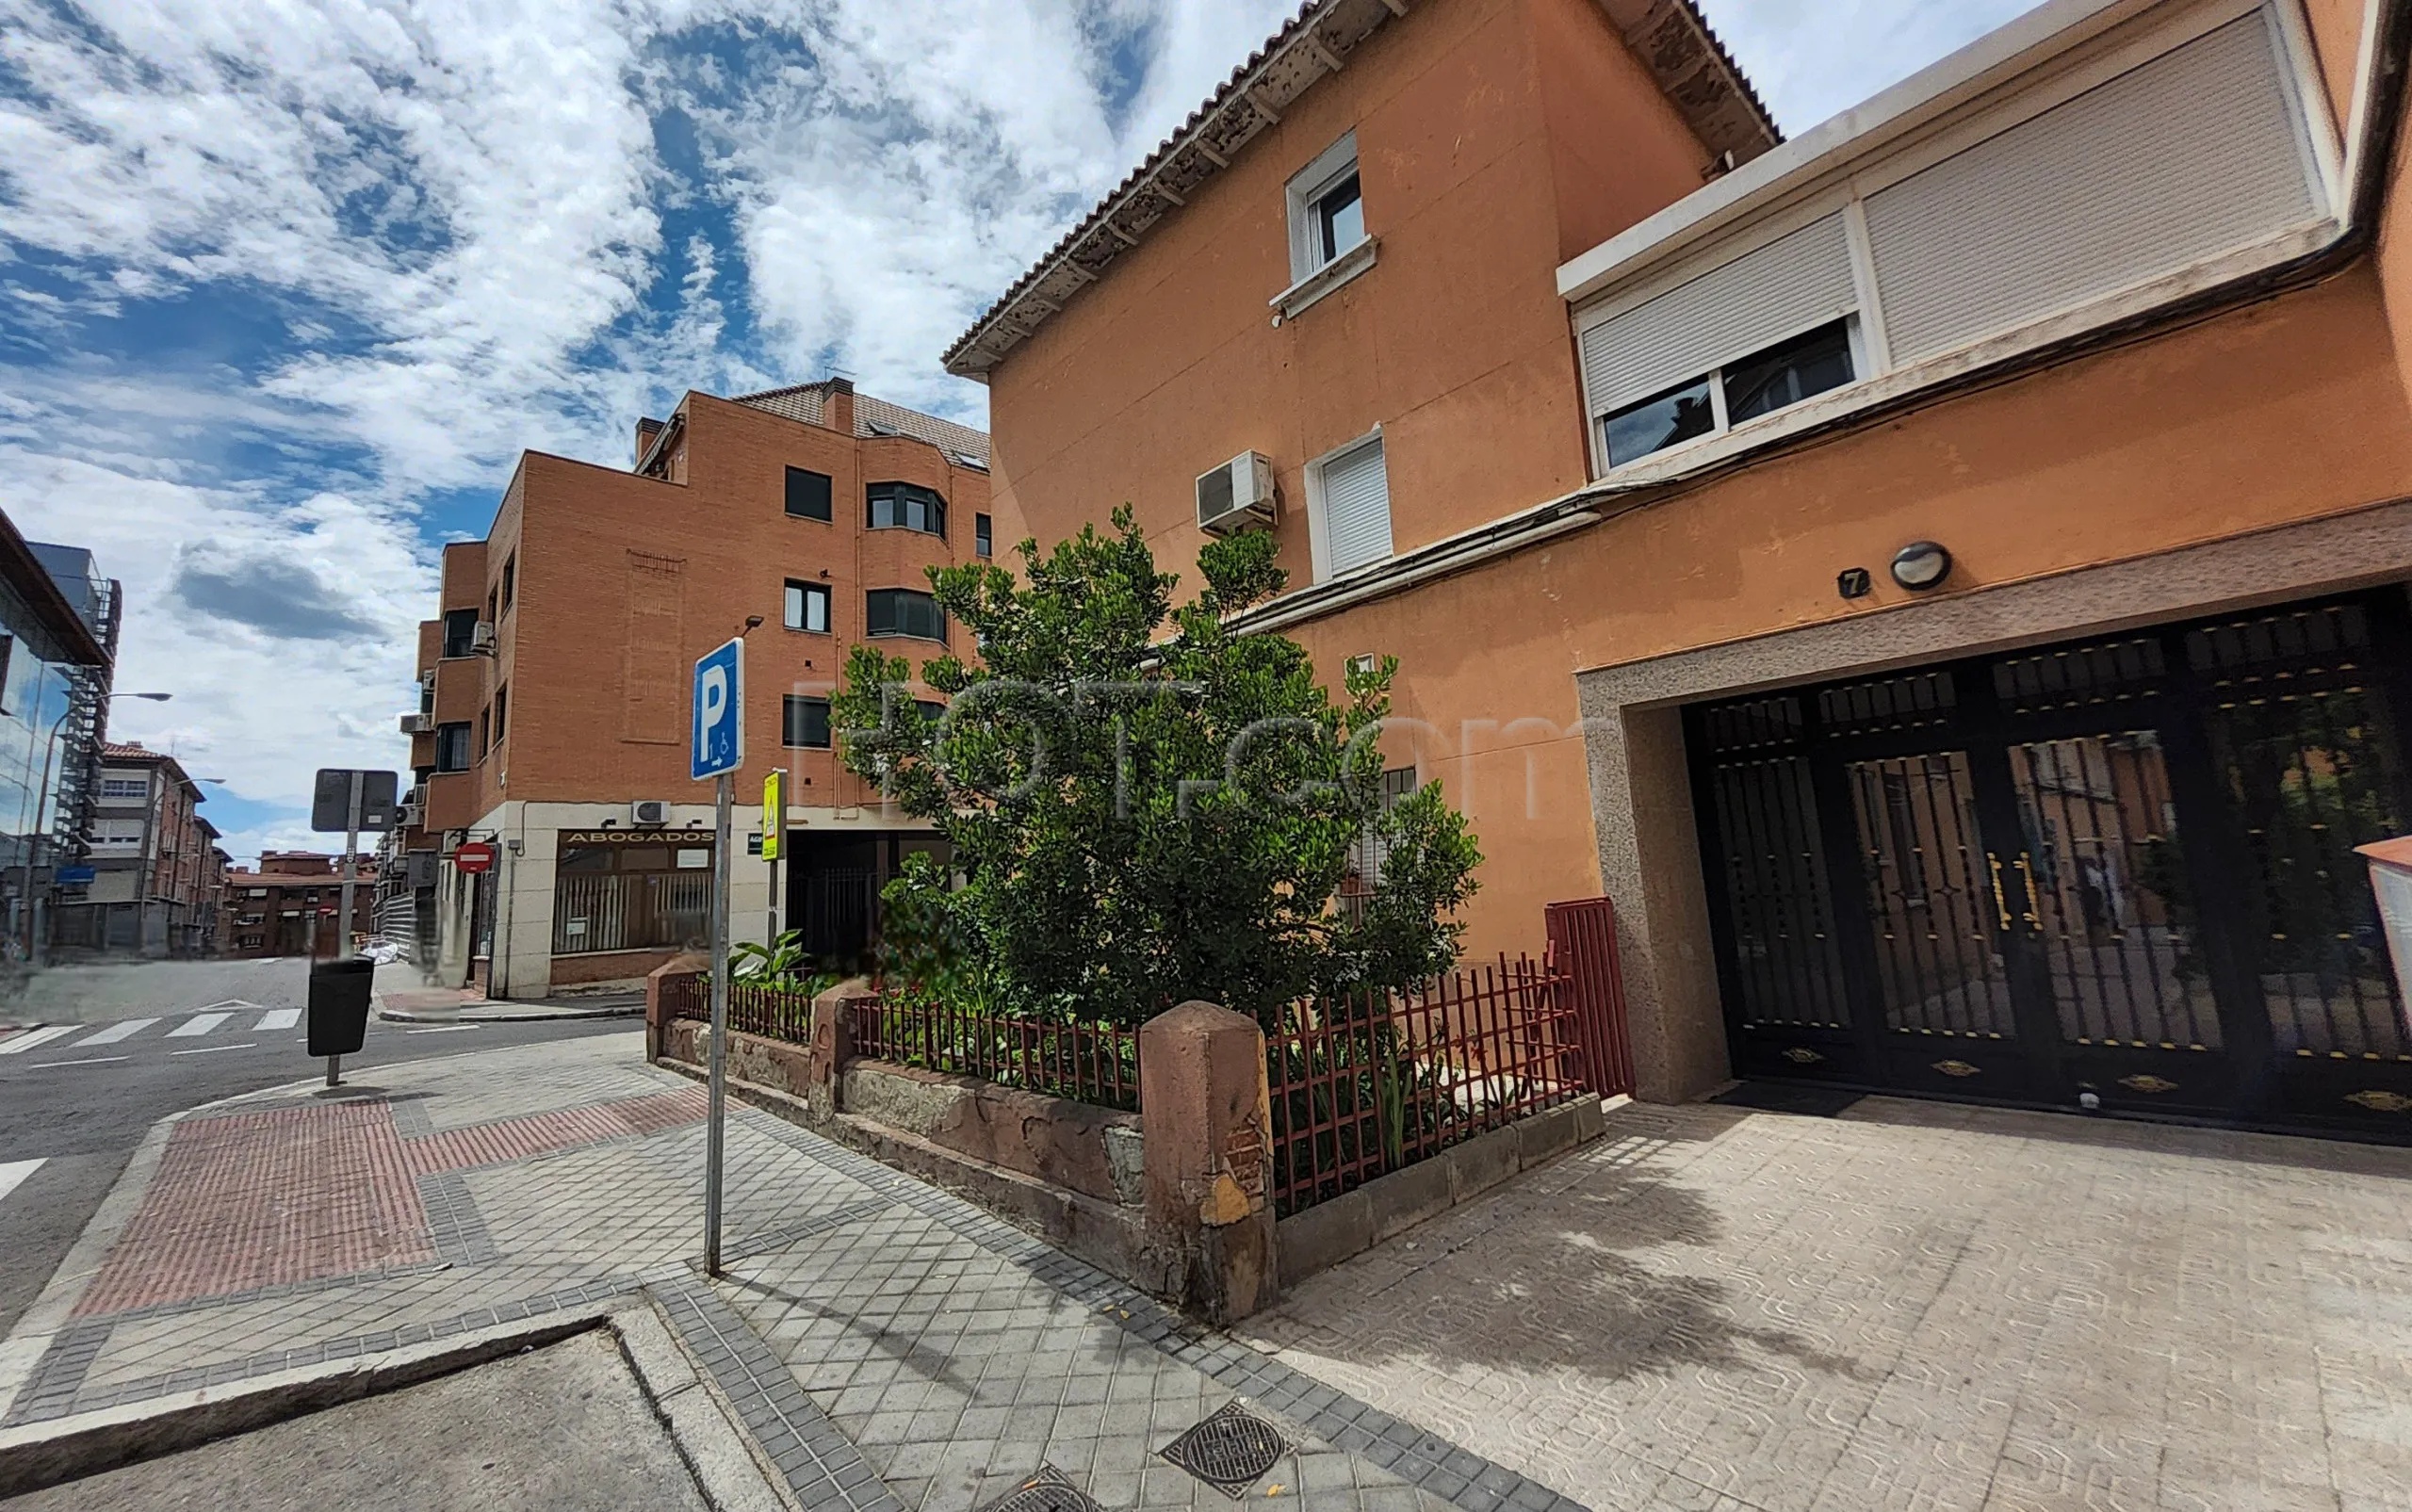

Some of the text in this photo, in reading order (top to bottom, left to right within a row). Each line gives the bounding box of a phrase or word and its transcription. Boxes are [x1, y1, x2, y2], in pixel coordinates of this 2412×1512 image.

[1844, 571, 1861, 594] 7
[700, 664, 727, 763] P
[566, 832, 715, 843] ABOGADOS
